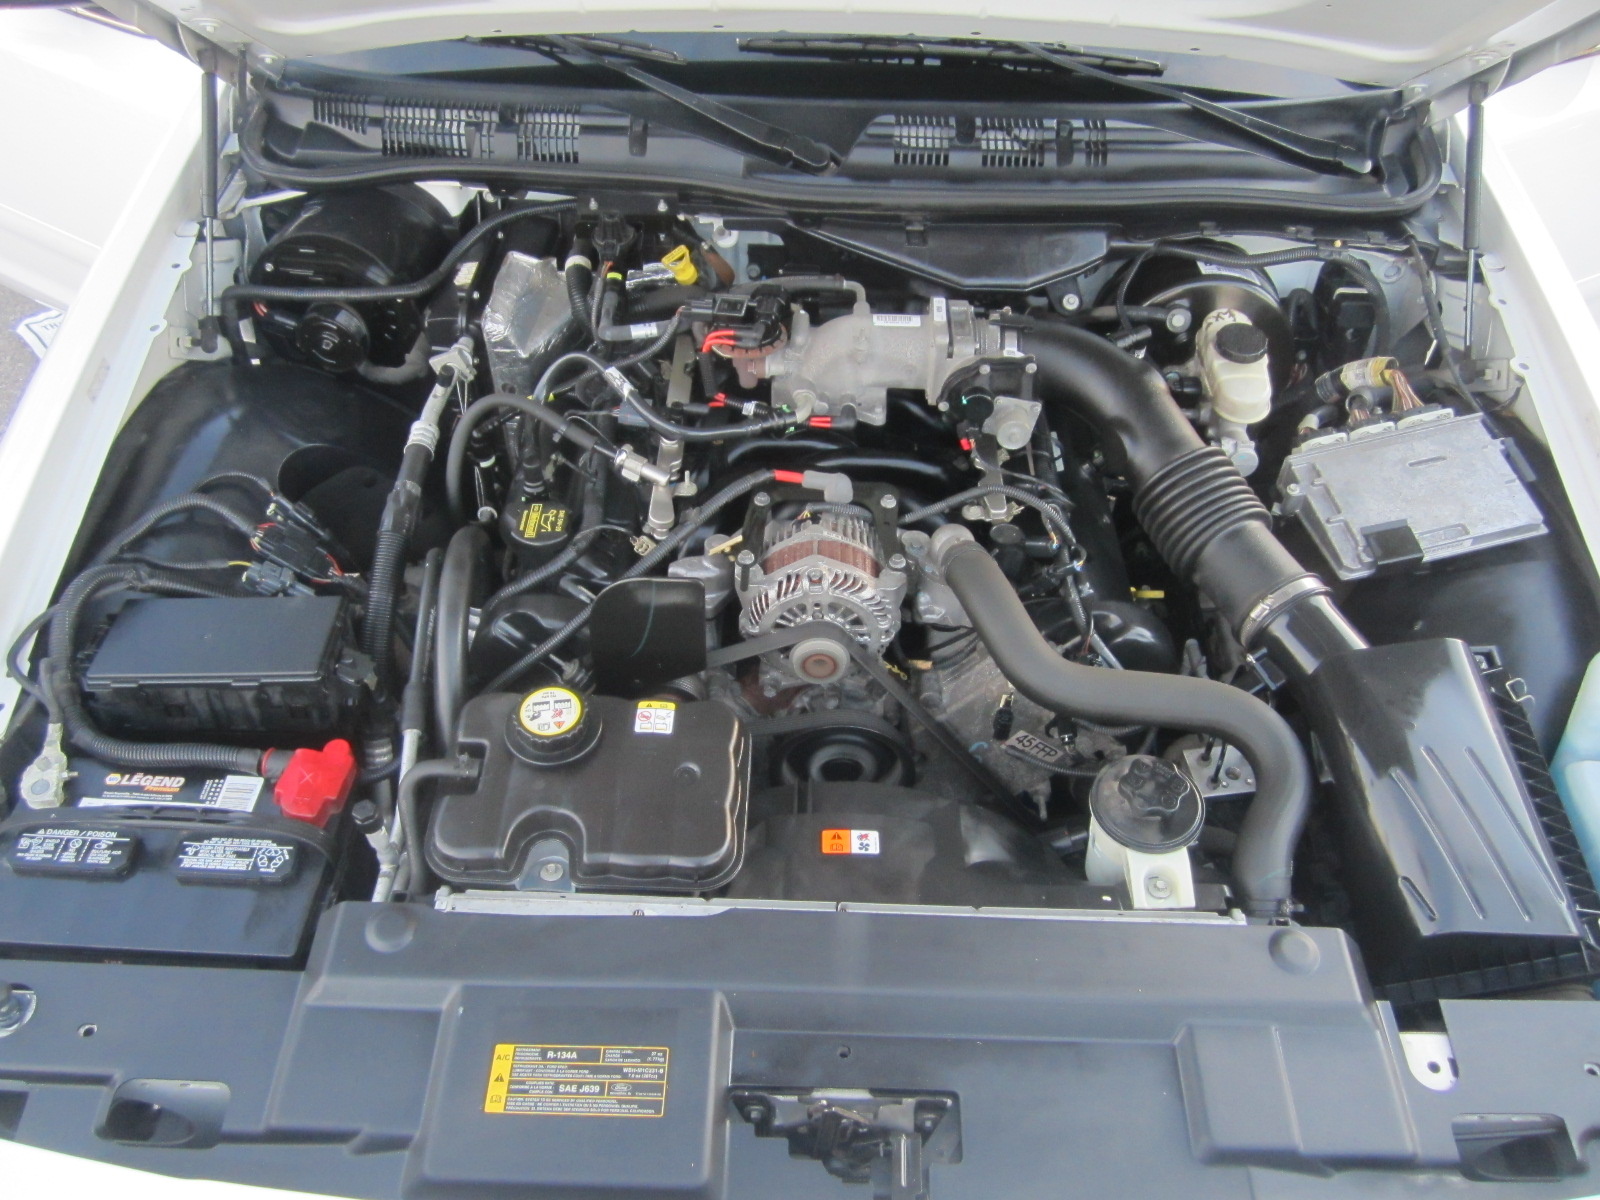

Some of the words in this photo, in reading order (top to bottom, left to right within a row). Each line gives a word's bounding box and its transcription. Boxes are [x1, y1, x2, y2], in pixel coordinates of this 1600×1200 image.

[120, 774, 185, 787] LEGEND
[144, 785, 180, 793] Premium
[46, 828, 80, 836] DANGER
[87, 830, 117, 838] POISON
[547, 1051, 578, 1059] R-134A
[558, 1085, 578, 1093] SAE
[579, 1085, 600, 1093] J639
